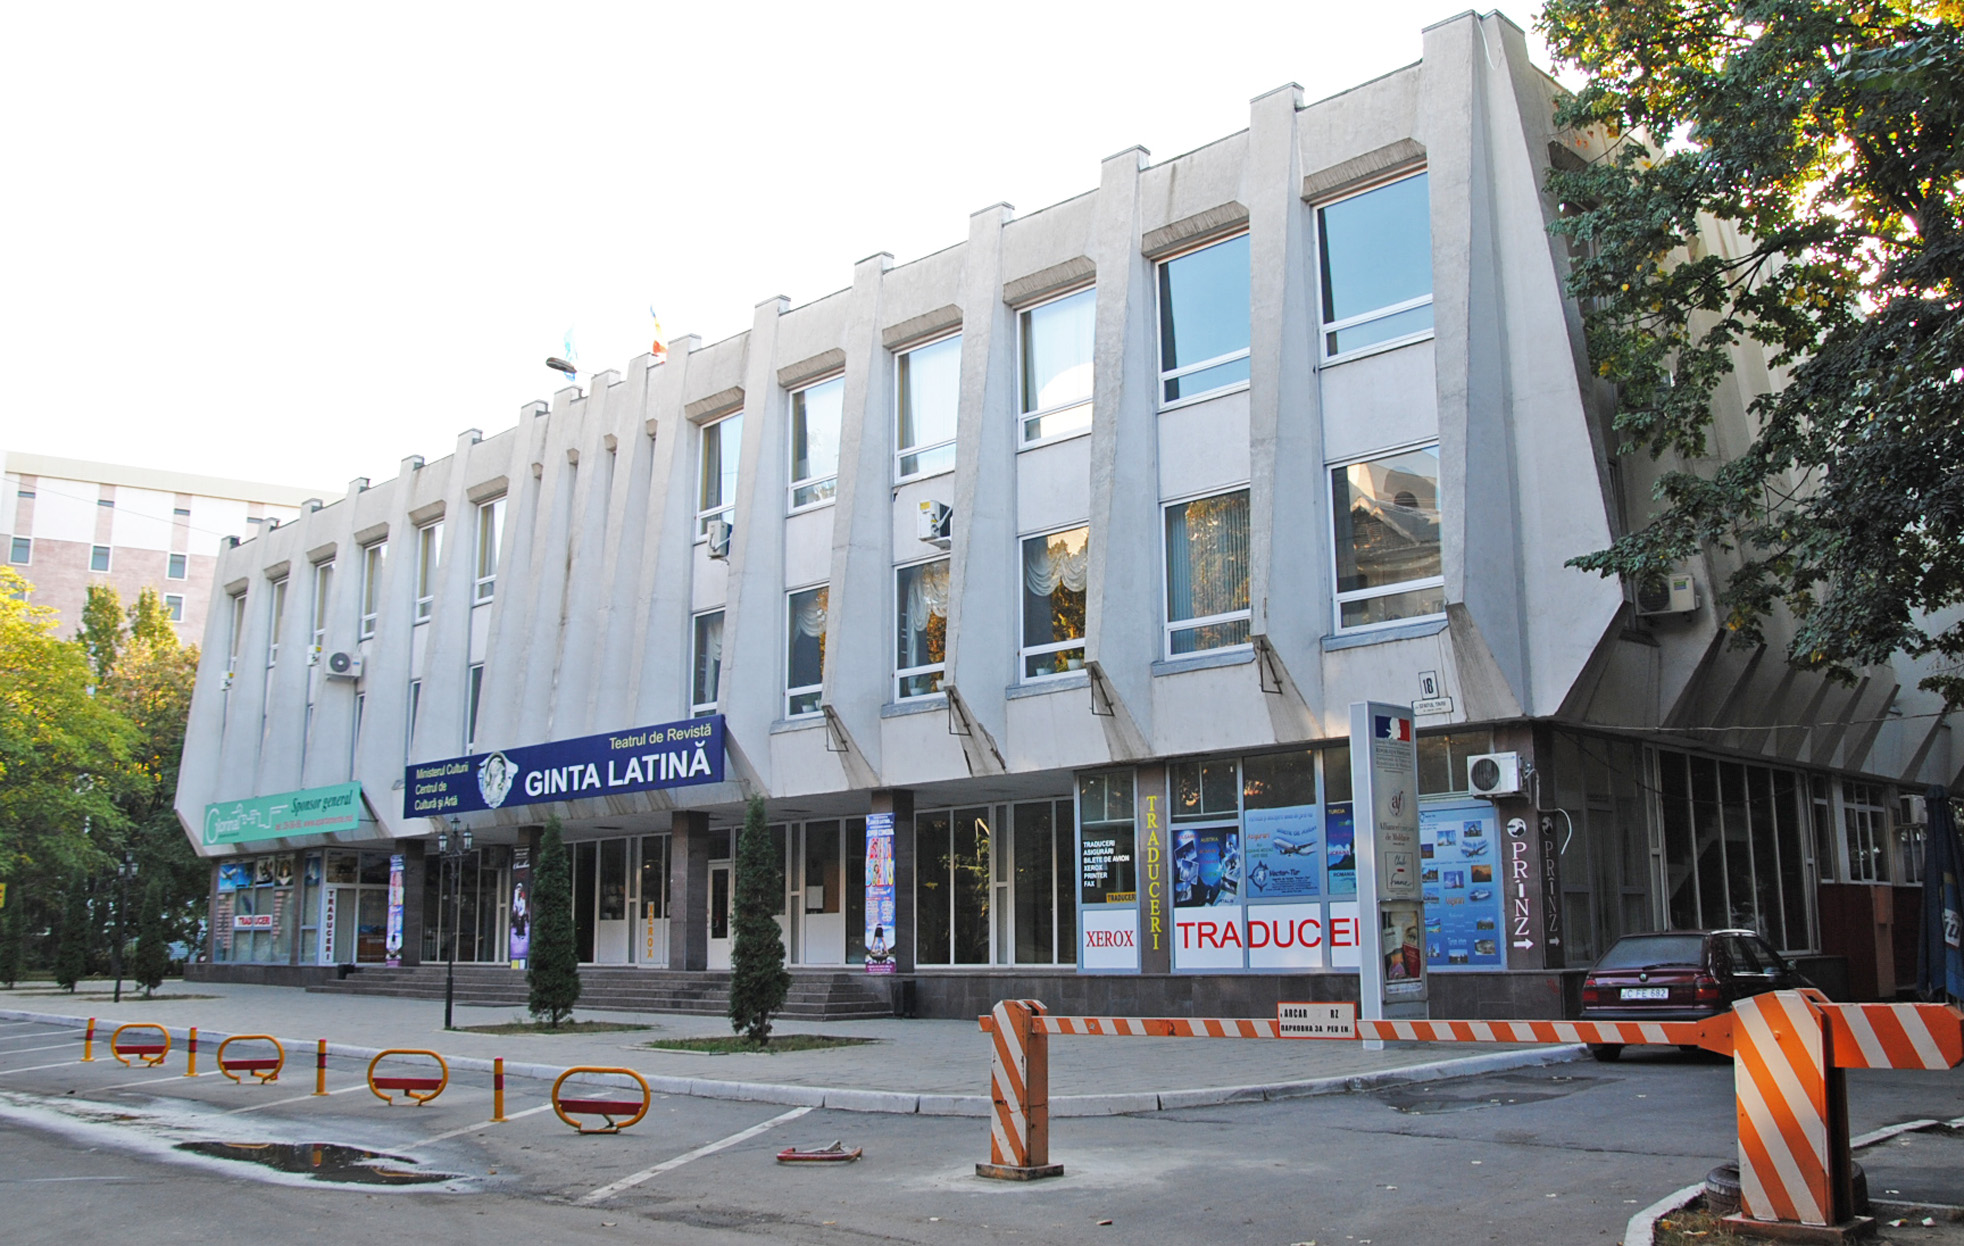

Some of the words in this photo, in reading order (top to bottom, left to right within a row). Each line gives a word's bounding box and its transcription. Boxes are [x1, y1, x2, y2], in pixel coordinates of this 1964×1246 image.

[1422, 677, 1434, 695] 18
[609, 732, 646, 750] Teatrul
[648, 730, 664, 744] de
[667, 723, 712, 741] Revistă
[416, 764, 446, 779] Ministerul
[446, 761, 469, 775] Culturii
[524, 763, 601, 797] GINTA
[607, 740, 711, 787] LATINĂ
[415, 781, 438, 795] Centrul
[438, 781, 448, 792] de
[291, 797, 322, 816] Sponsor
[322, 789, 353, 812] general
[414, 797, 437, 811] Cultură
[1083, 840, 1115, 848] TRADUCERI
[1083, 856, 1103, 864] BILETE
[1103, 855, 1112, 863] DE
[1112, 854, 1130, 862] AVION
[1083, 871, 1108, 880] PRINTER
[1146, 795, 1162, 950] TRADUCERI
[1083, 880, 1096, 888] FAX
[325, 890, 334, 961] TRADUCERI
[1176, 918, 1360, 949] TRADUCE
[1086, 930, 1135, 948] XEROX
